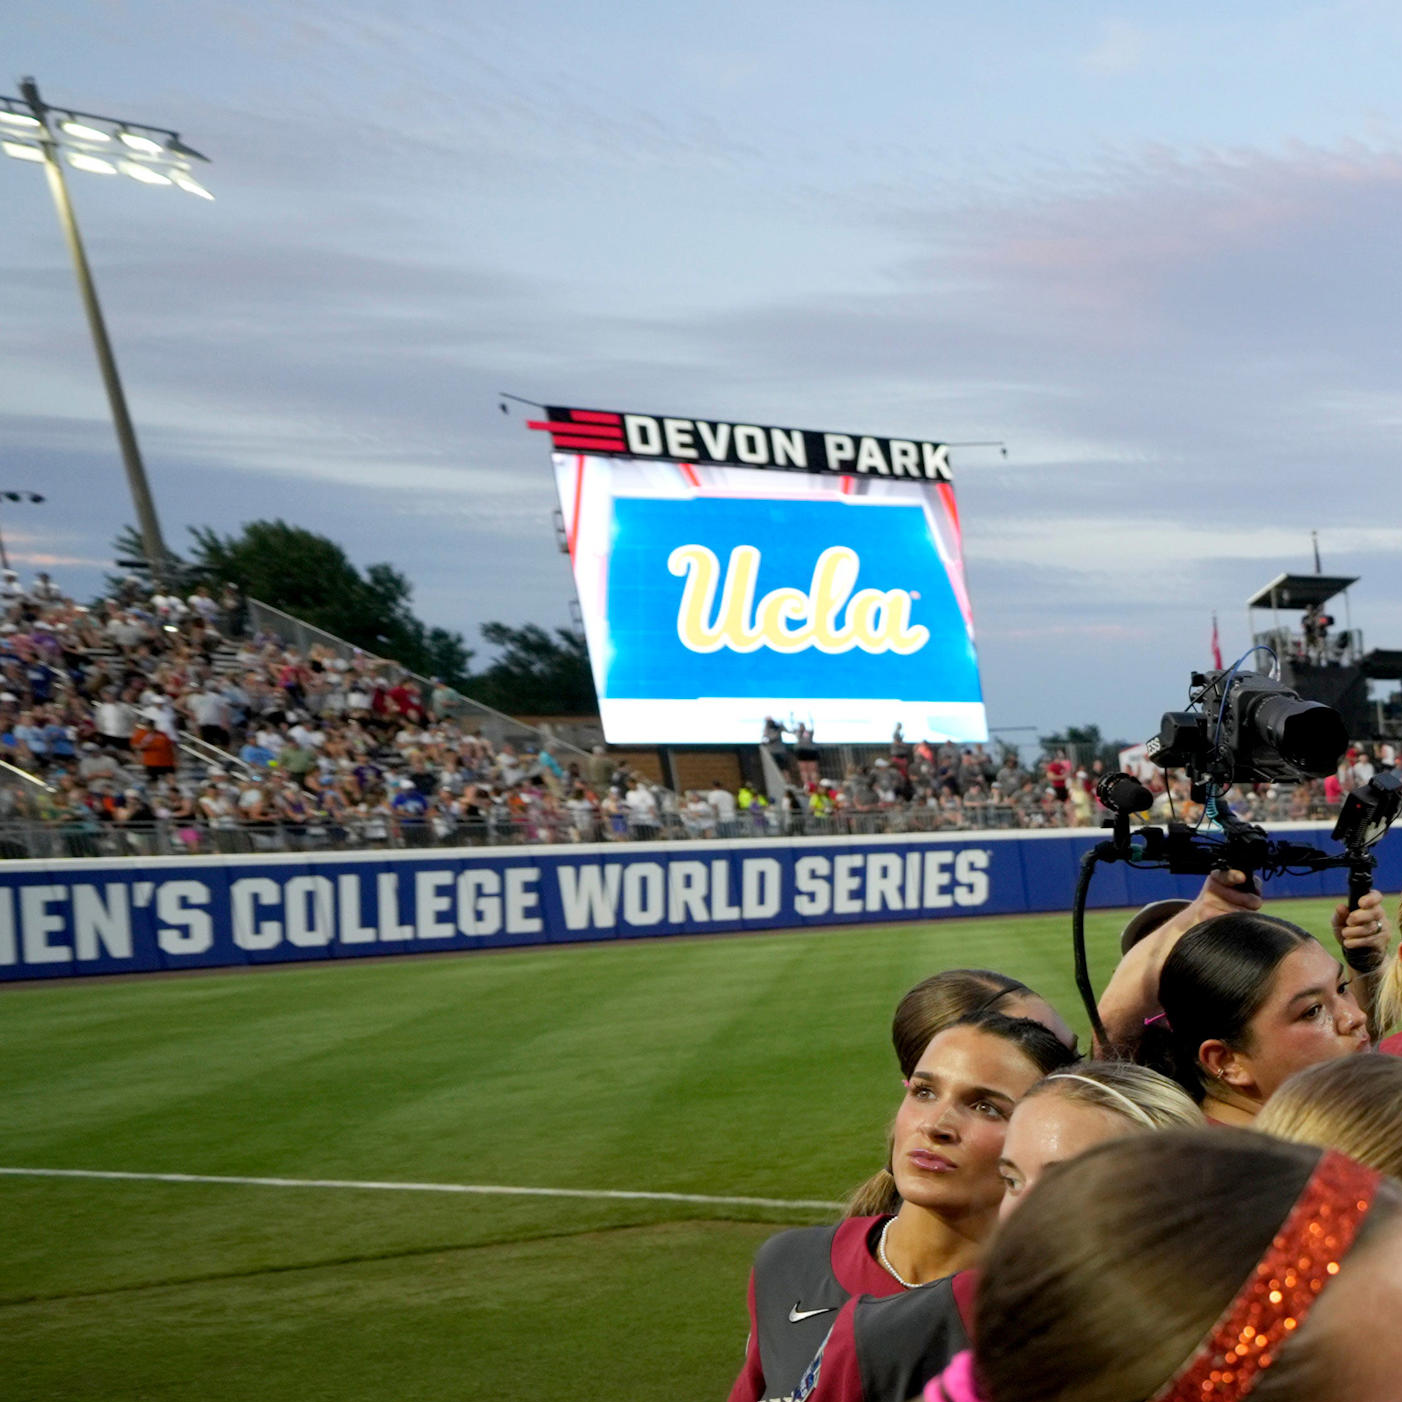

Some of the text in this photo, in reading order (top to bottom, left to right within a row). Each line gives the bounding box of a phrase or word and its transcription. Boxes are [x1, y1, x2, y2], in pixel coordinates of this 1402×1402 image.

[623, 414, 952, 481] DEVON PARK
[230, 867, 544, 950] COLLEGE
[556, 857, 781, 931] WORLD
[793, 848, 990, 917] SERIES
